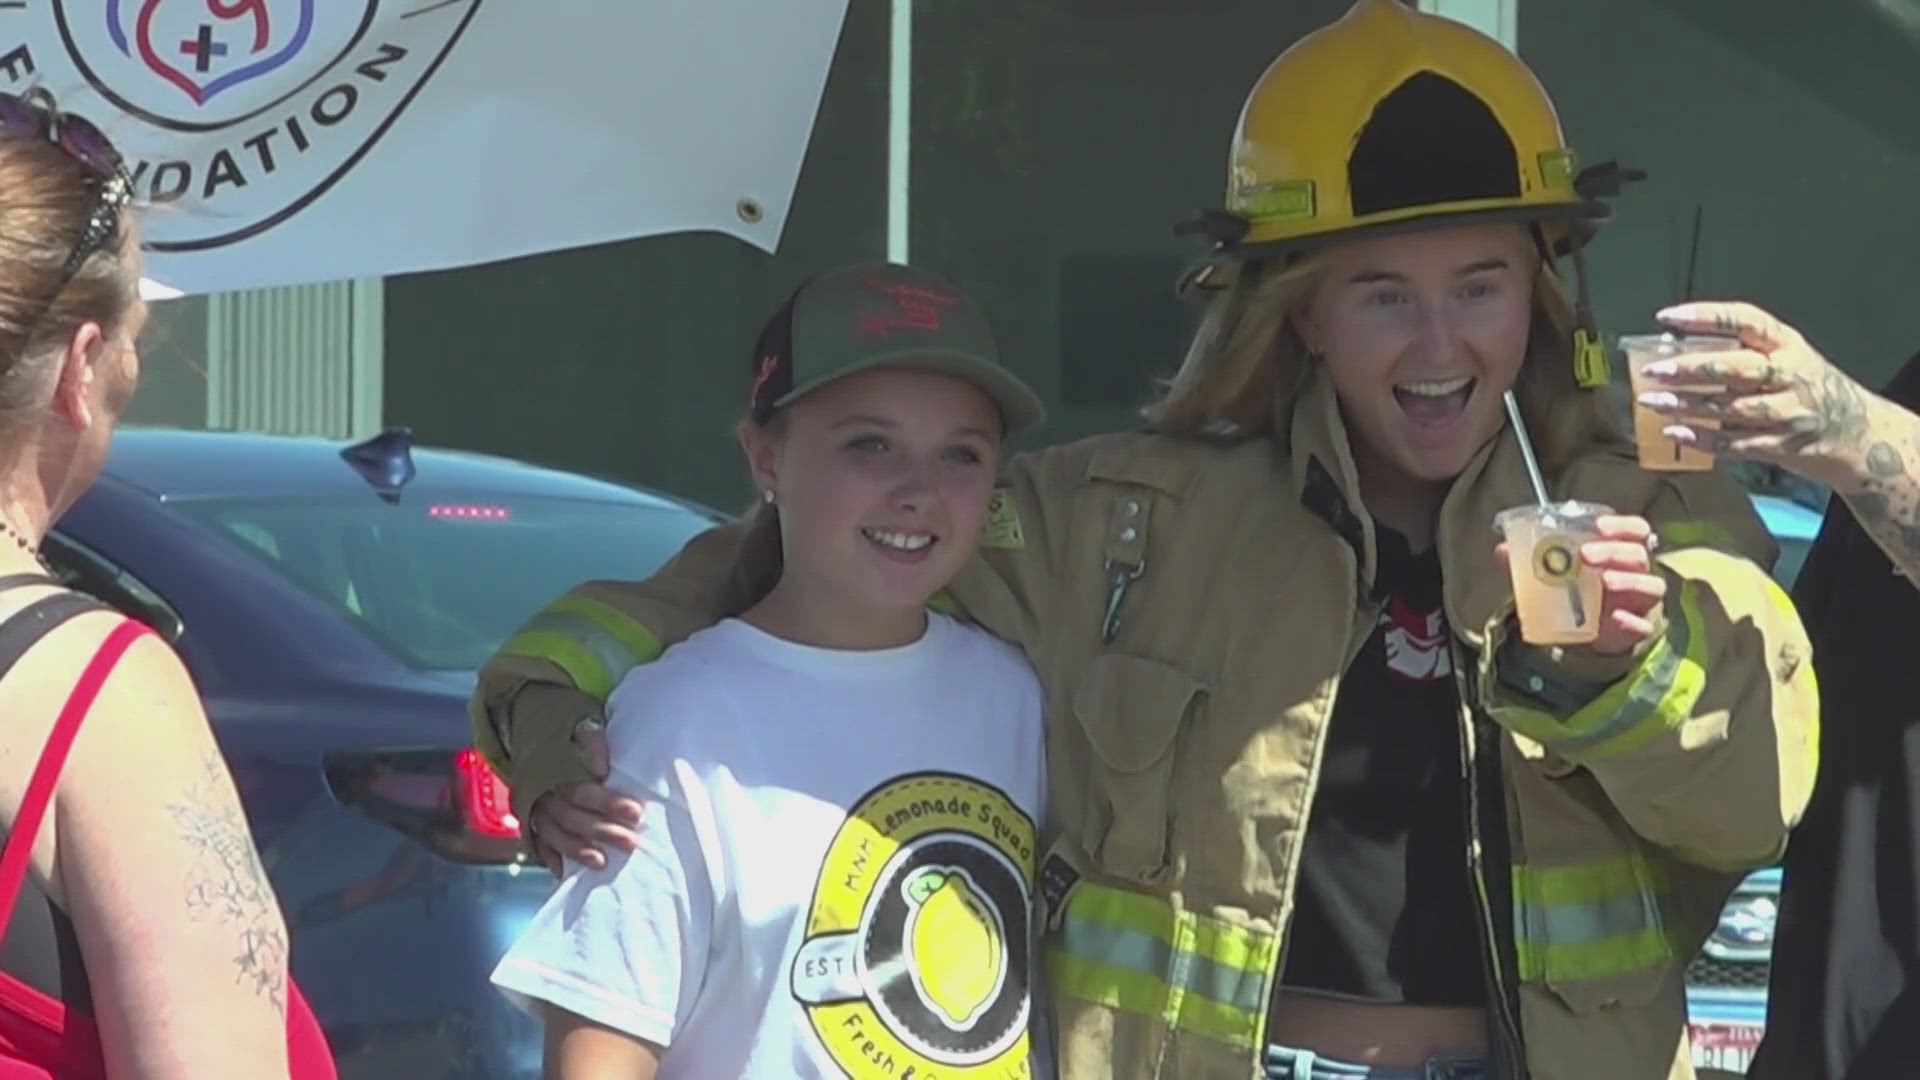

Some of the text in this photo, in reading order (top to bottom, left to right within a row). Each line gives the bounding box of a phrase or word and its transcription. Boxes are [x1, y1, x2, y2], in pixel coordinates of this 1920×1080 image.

[872, 796, 971, 838] Lemonade
[805, 957, 842, 978] EST
[843, 1013, 895, 1075] Fresh
